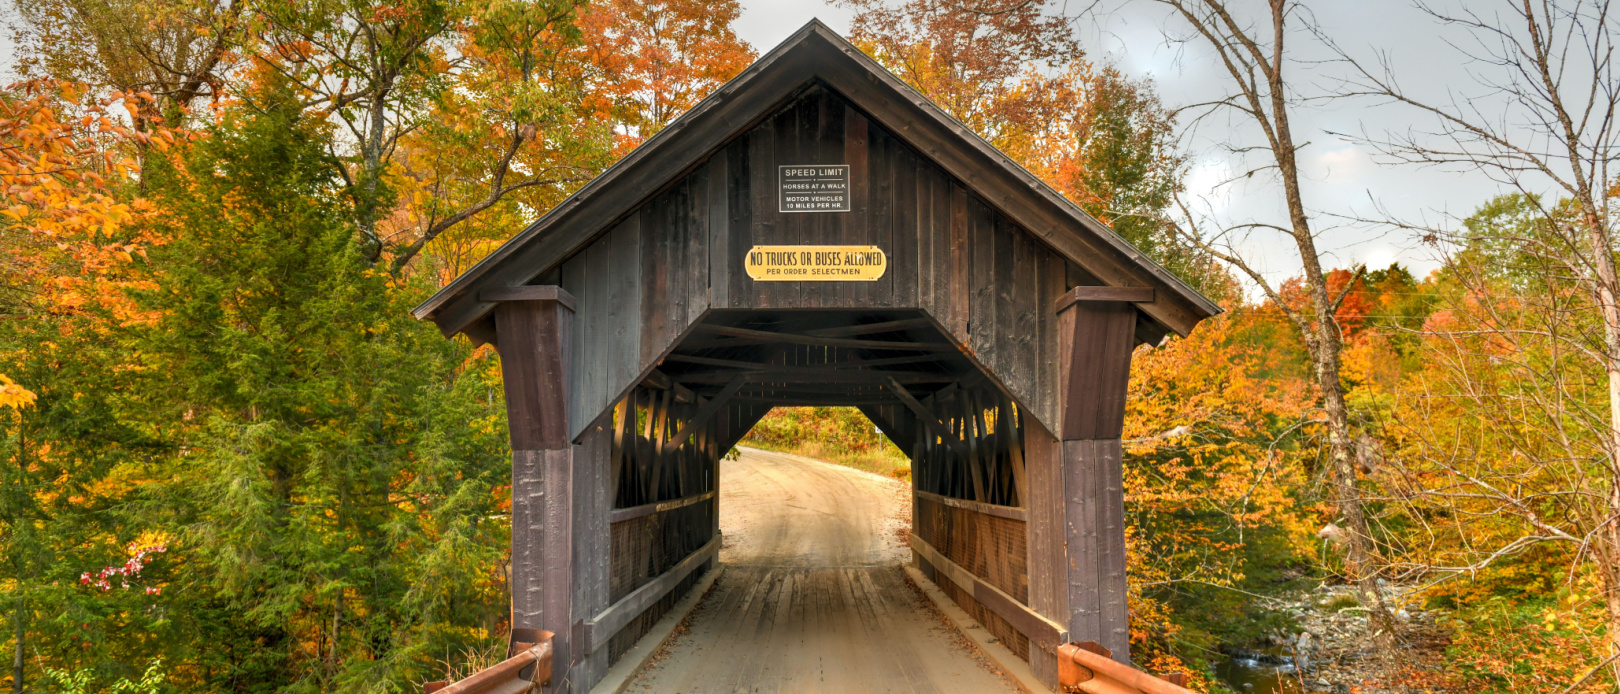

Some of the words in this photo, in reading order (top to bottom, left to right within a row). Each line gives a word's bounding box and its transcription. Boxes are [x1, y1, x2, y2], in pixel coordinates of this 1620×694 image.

[750, 252, 762, 266] NO
[766, 252, 797, 266] TRUCKS
[801, 252, 812, 266] OR
[816, 252, 841, 266] BUSES
[844, 252, 882, 266] ALLOWED
